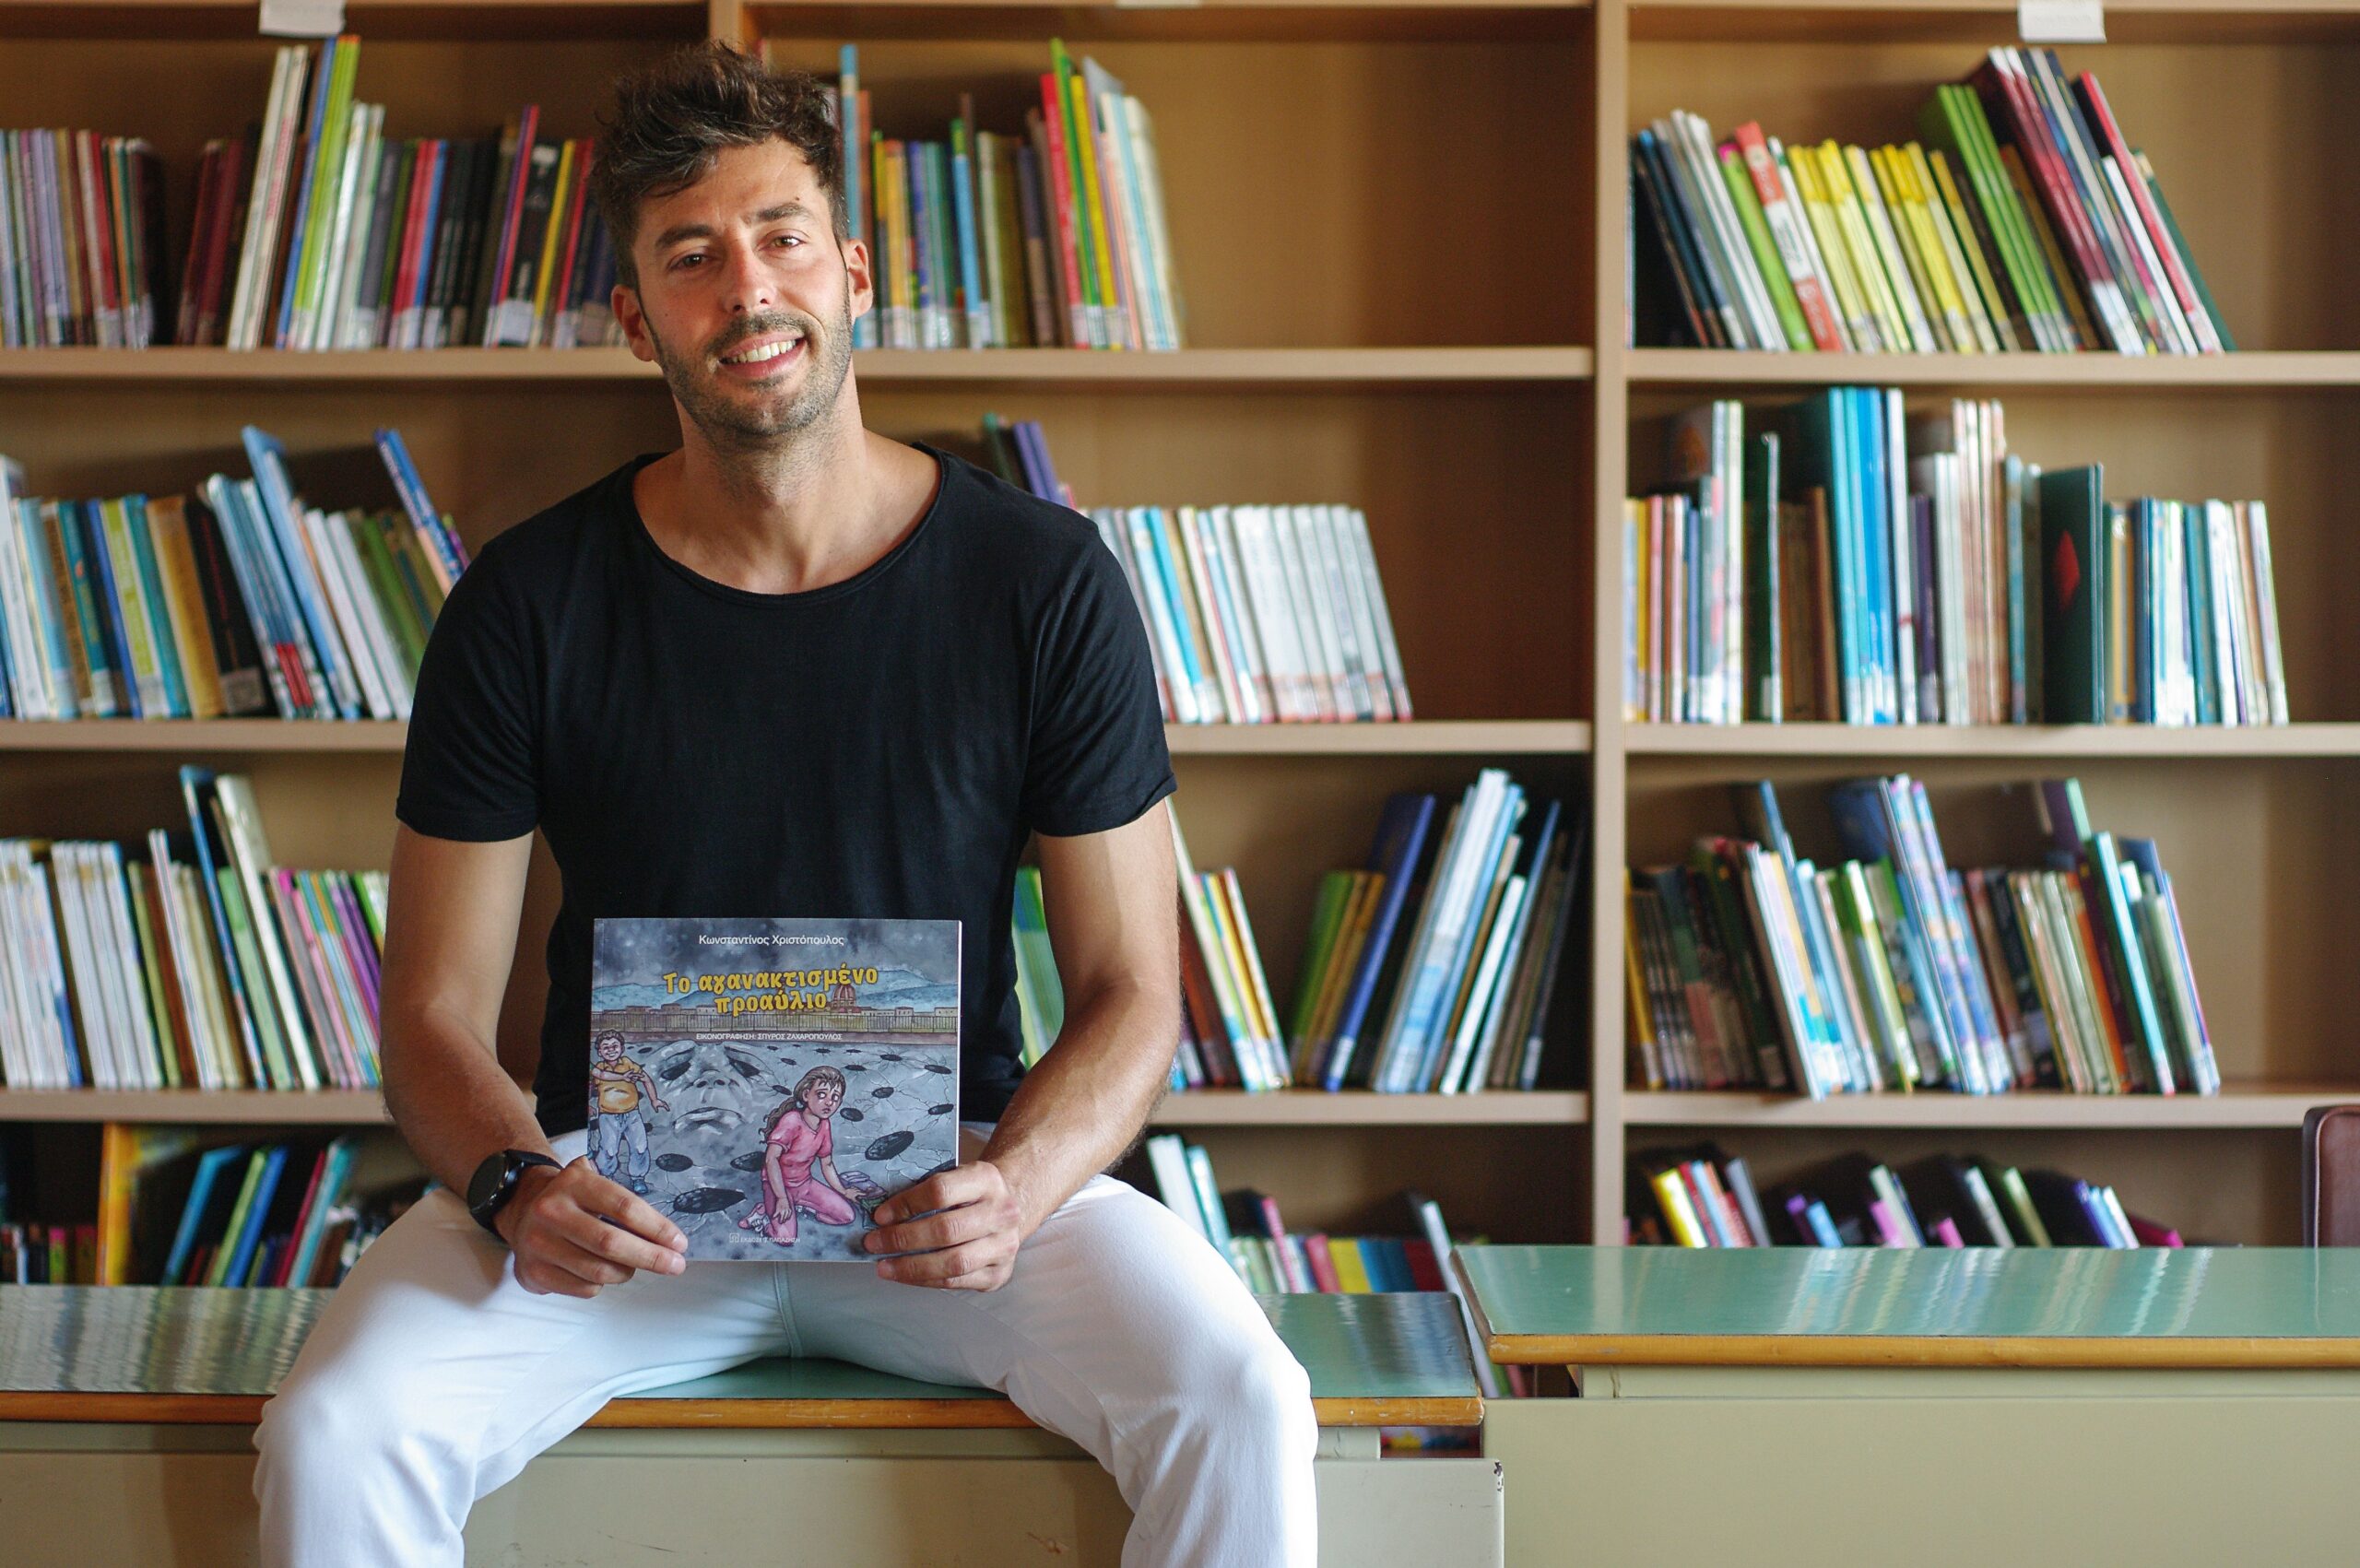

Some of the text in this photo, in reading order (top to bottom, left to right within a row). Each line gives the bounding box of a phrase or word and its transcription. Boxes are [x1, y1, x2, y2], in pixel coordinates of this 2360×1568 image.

[699, 935, 844, 946] Κωνσταντίνος Χριστόπουλος
[663, 961, 879, 996] Το αγανακτισμένο
[714, 989, 828, 1018] προαύλιο
[758, 1032, 785, 1041] ΣΠΥΡΟΣ
